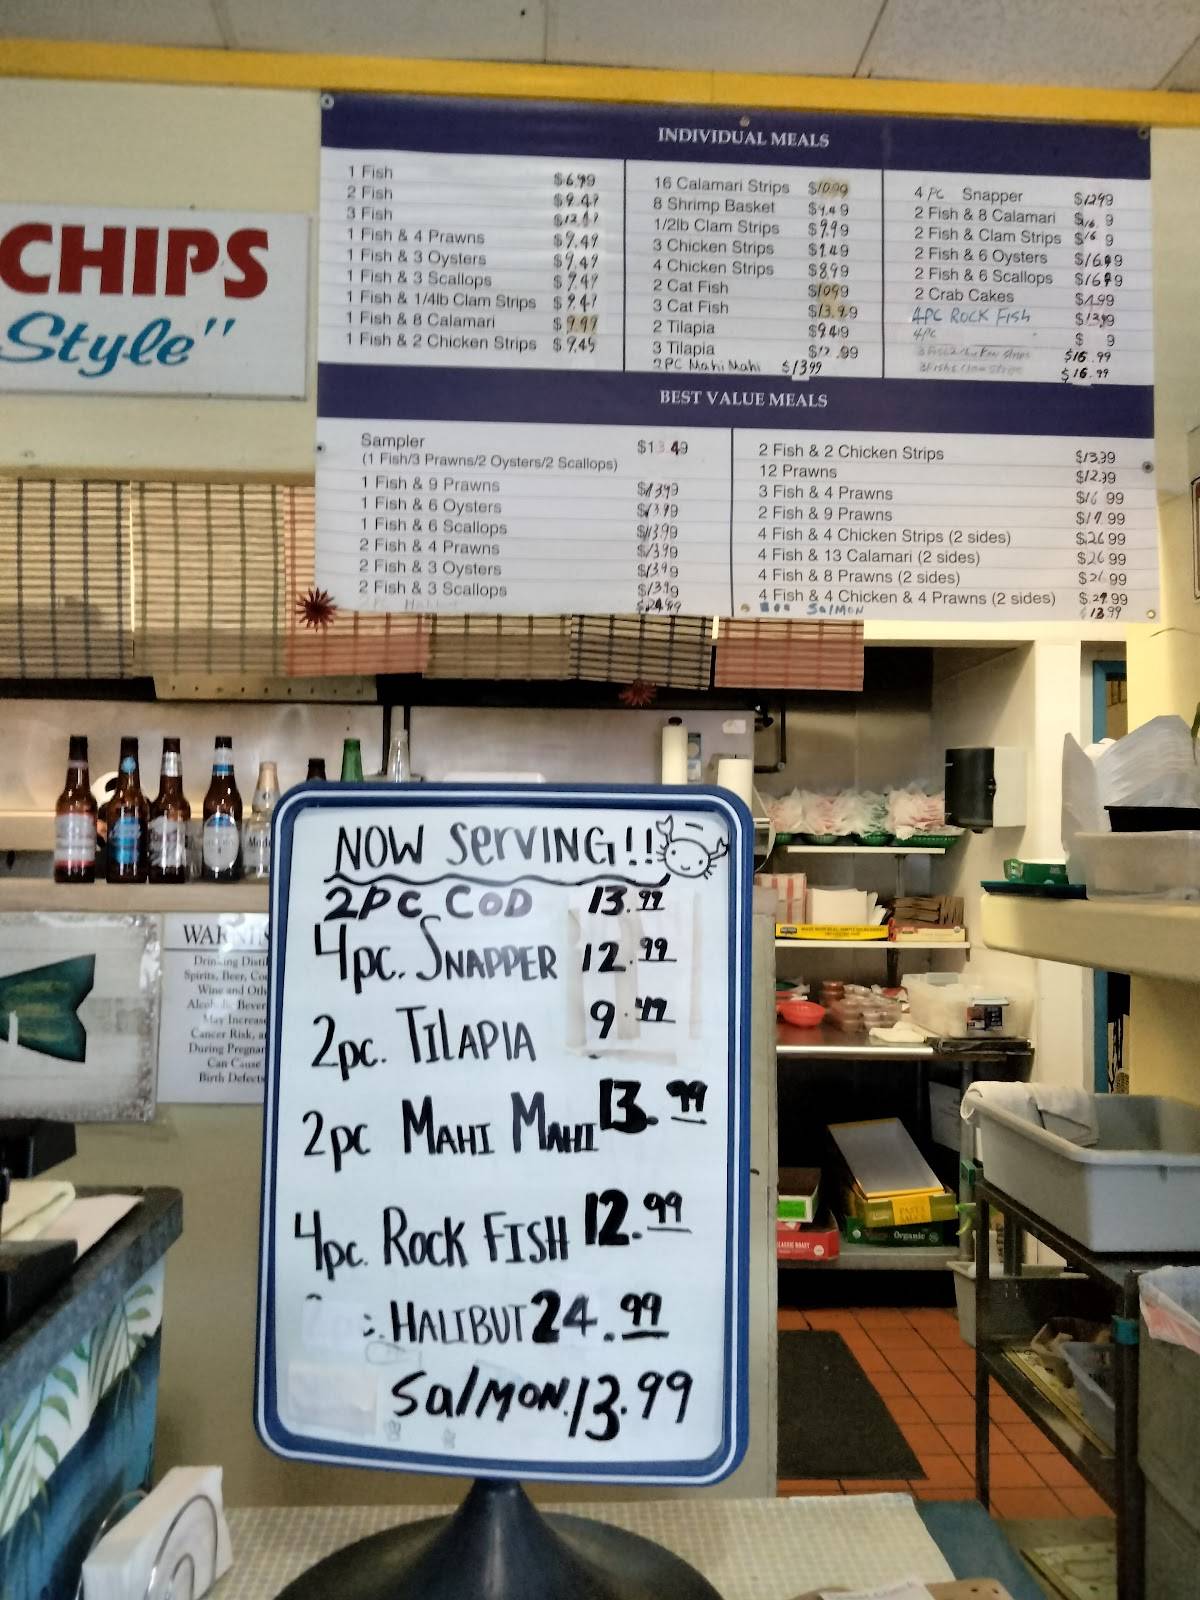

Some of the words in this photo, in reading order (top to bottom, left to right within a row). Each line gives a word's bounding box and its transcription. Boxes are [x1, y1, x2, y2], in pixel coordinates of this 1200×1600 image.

[659, 128, 766, 145] INDIVIDUAL
[771, 132, 829, 147] MEALS
[362, 165, 392, 179] Fish
[362, 186, 392, 200] Fish
[656, 176, 671, 189] 16
[677, 177, 742, 192] Calamari
[748, 179, 789, 196] Strips
[963, 187, 1023, 205] Snapper
[362, 207, 392, 220] Fish
[668, 197, 719, 215] Shrimp
[725, 199, 774, 213] Basket
[929, 207, 958, 220] Fish
[992, 209, 1055, 224] Calamari
[362, 227, 392, 241] Fish
[429, 229, 484, 244] Prawns
[695, 219, 732, 232] Clam
[738, 220, 779, 238] Strips
[929, 227, 958, 240] Fish
[979, 228, 1015, 242] Clam
[1021, 230, 1061, 247] Strips
[667, 239, 726, 253] Chicken
[733, 240, 774, 257] Strips
[929, 247, 958, 260] Fish
[993, 249, 1047, 266] Oysters
[0, 221, 269, 300] CHIPS
[361, 248, 391, 262] Fish
[428, 250, 486, 268] Oysters
[668, 259, 726, 273] Chicken
[733, 261, 773, 278] Strips
[929, 267, 958, 280] Fish
[993, 269, 1053, 287] Scallops
[361, 269, 391, 283] Fish
[429, 271, 491, 290] Scallops
[668, 279, 692, 292] Cat
[699, 281, 728, 293] Fish
[361, 290, 391, 304] Fish
[454, 293, 490, 307] Clam
[496, 295, 536, 312] Strips
[929, 287, 964, 301] Crab
[969, 289, 1014, 302] Cakes
[668, 299, 692, 312] Cat
[699, 300, 728, 313] Fish
[951, 307, 989, 323] ROCK
[361, 311, 391, 325] Fish
[428, 313, 494, 328] Calamari
[668, 320, 714, 337] Tilapia
[360, 332, 391, 346] Fish
[428, 334, 488, 349] Chicken
[495, 336, 536, 353] Strips
[667, 341, 714, 357] Tilapia
[661, 390, 702, 404] BEST
[707, 391, 764, 406] VALUE
[770, 393, 827, 407] MEALS
[362, 433, 424, 451] Sampler
[381, 452, 419, 465] Fish/3
[425, 453, 486, 466] Prawns/2
[491, 455, 553, 470] Oysters/2
[559, 457, 617, 472] Scallops)
[774, 443, 803, 456] Fish
[839, 445, 897, 459] Chicken
[903, 446, 944, 463] Strips
[783, 464, 837, 478] Prawns
[376, 476, 406, 490] Fish
[444, 477, 499, 492] Prawns
[774, 485, 803, 498] Fish
[839, 486, 892, 500] Prawns
[376, 496, 406, 510] Fish
[444, 499, 501, 517] Oysters
[773, 506, 803, 520] Fish
[839, 507, 892, 521] Prawns
[376, 518, 406, 531] Fish
[444, 519, 507, 538] Scallops
[773, 527, 802, 540] Fish
[838, 528, 896, 542] Chicken
[902, 529, 943, 545] Strips
[375, 538, 406, 552] Fish
[444, 540, 499, 555] Prawns
[773, 548, 802, 561] Fish
[847, 549, 912, 562] Calamari
[375, 559, 405, 573] Fish
[443, 560, 501, 578] Oysters
[773, 568, 802, 581] Fish
[839, 570, 892, 583] Prawns
[917, 571, 960, 588] sides)
[375, 581, 405, 594] Fish
[443, 582, 507, 599] Scallops
[774, 589, 803, 601] Fish
[839, 590, 897, 603] Chicken
[933, 591, 986, 604] Prawns
[1011, 592, 1055, 607] sides)
[335, 823, 425, 872] NOW
[325, 885, 422, 921] 2PC
[446, 888, 533, 919] COD
[589, 886, 664, 915] 13.99
[194, 955, 238, 968] Drining
[314, 923, 405, 994] 4pc.
[417, 915, 558, 982] SNAPPER
[583, 937, 676, 973] 12.99
[184, 971, 218, 982] Spirits,
[222, 971, 247, 981] Beer,
[199, 985, 222, 995] Wine
[226, 985, 243, 995] and
[191, 1029, 225, 1039] Cancer
[230, 1029, 255, 1040] Risk,
[189, 1043, 224, 1055] During
[311, 1014, 386, 1080] 2pc.
[207, 1058, 227, 1068] Can
[231, 1058, 261, 1069] Cause
[199, 1072, 224, 1083] Birth
[303, 1111, 370, 1172] 2pc
[402, 1096, 495, 1156] MAHI
[511, 1092, 599, 1154] MAHI
[600, 1078, 708, 1134] 13.99
[295, 1210, 369, 1280] 4pc.
[484, 1211, 570, 1263] FISH
[585, 1188, 692, 1246] 12.99
[894, 1231, 925, 1240] Organic
[391, 1300, 526, 1344] HALIBUT
[530, 1289, 669, 1344] 24.99
[568, 1370, 692, 1441] 13.99
